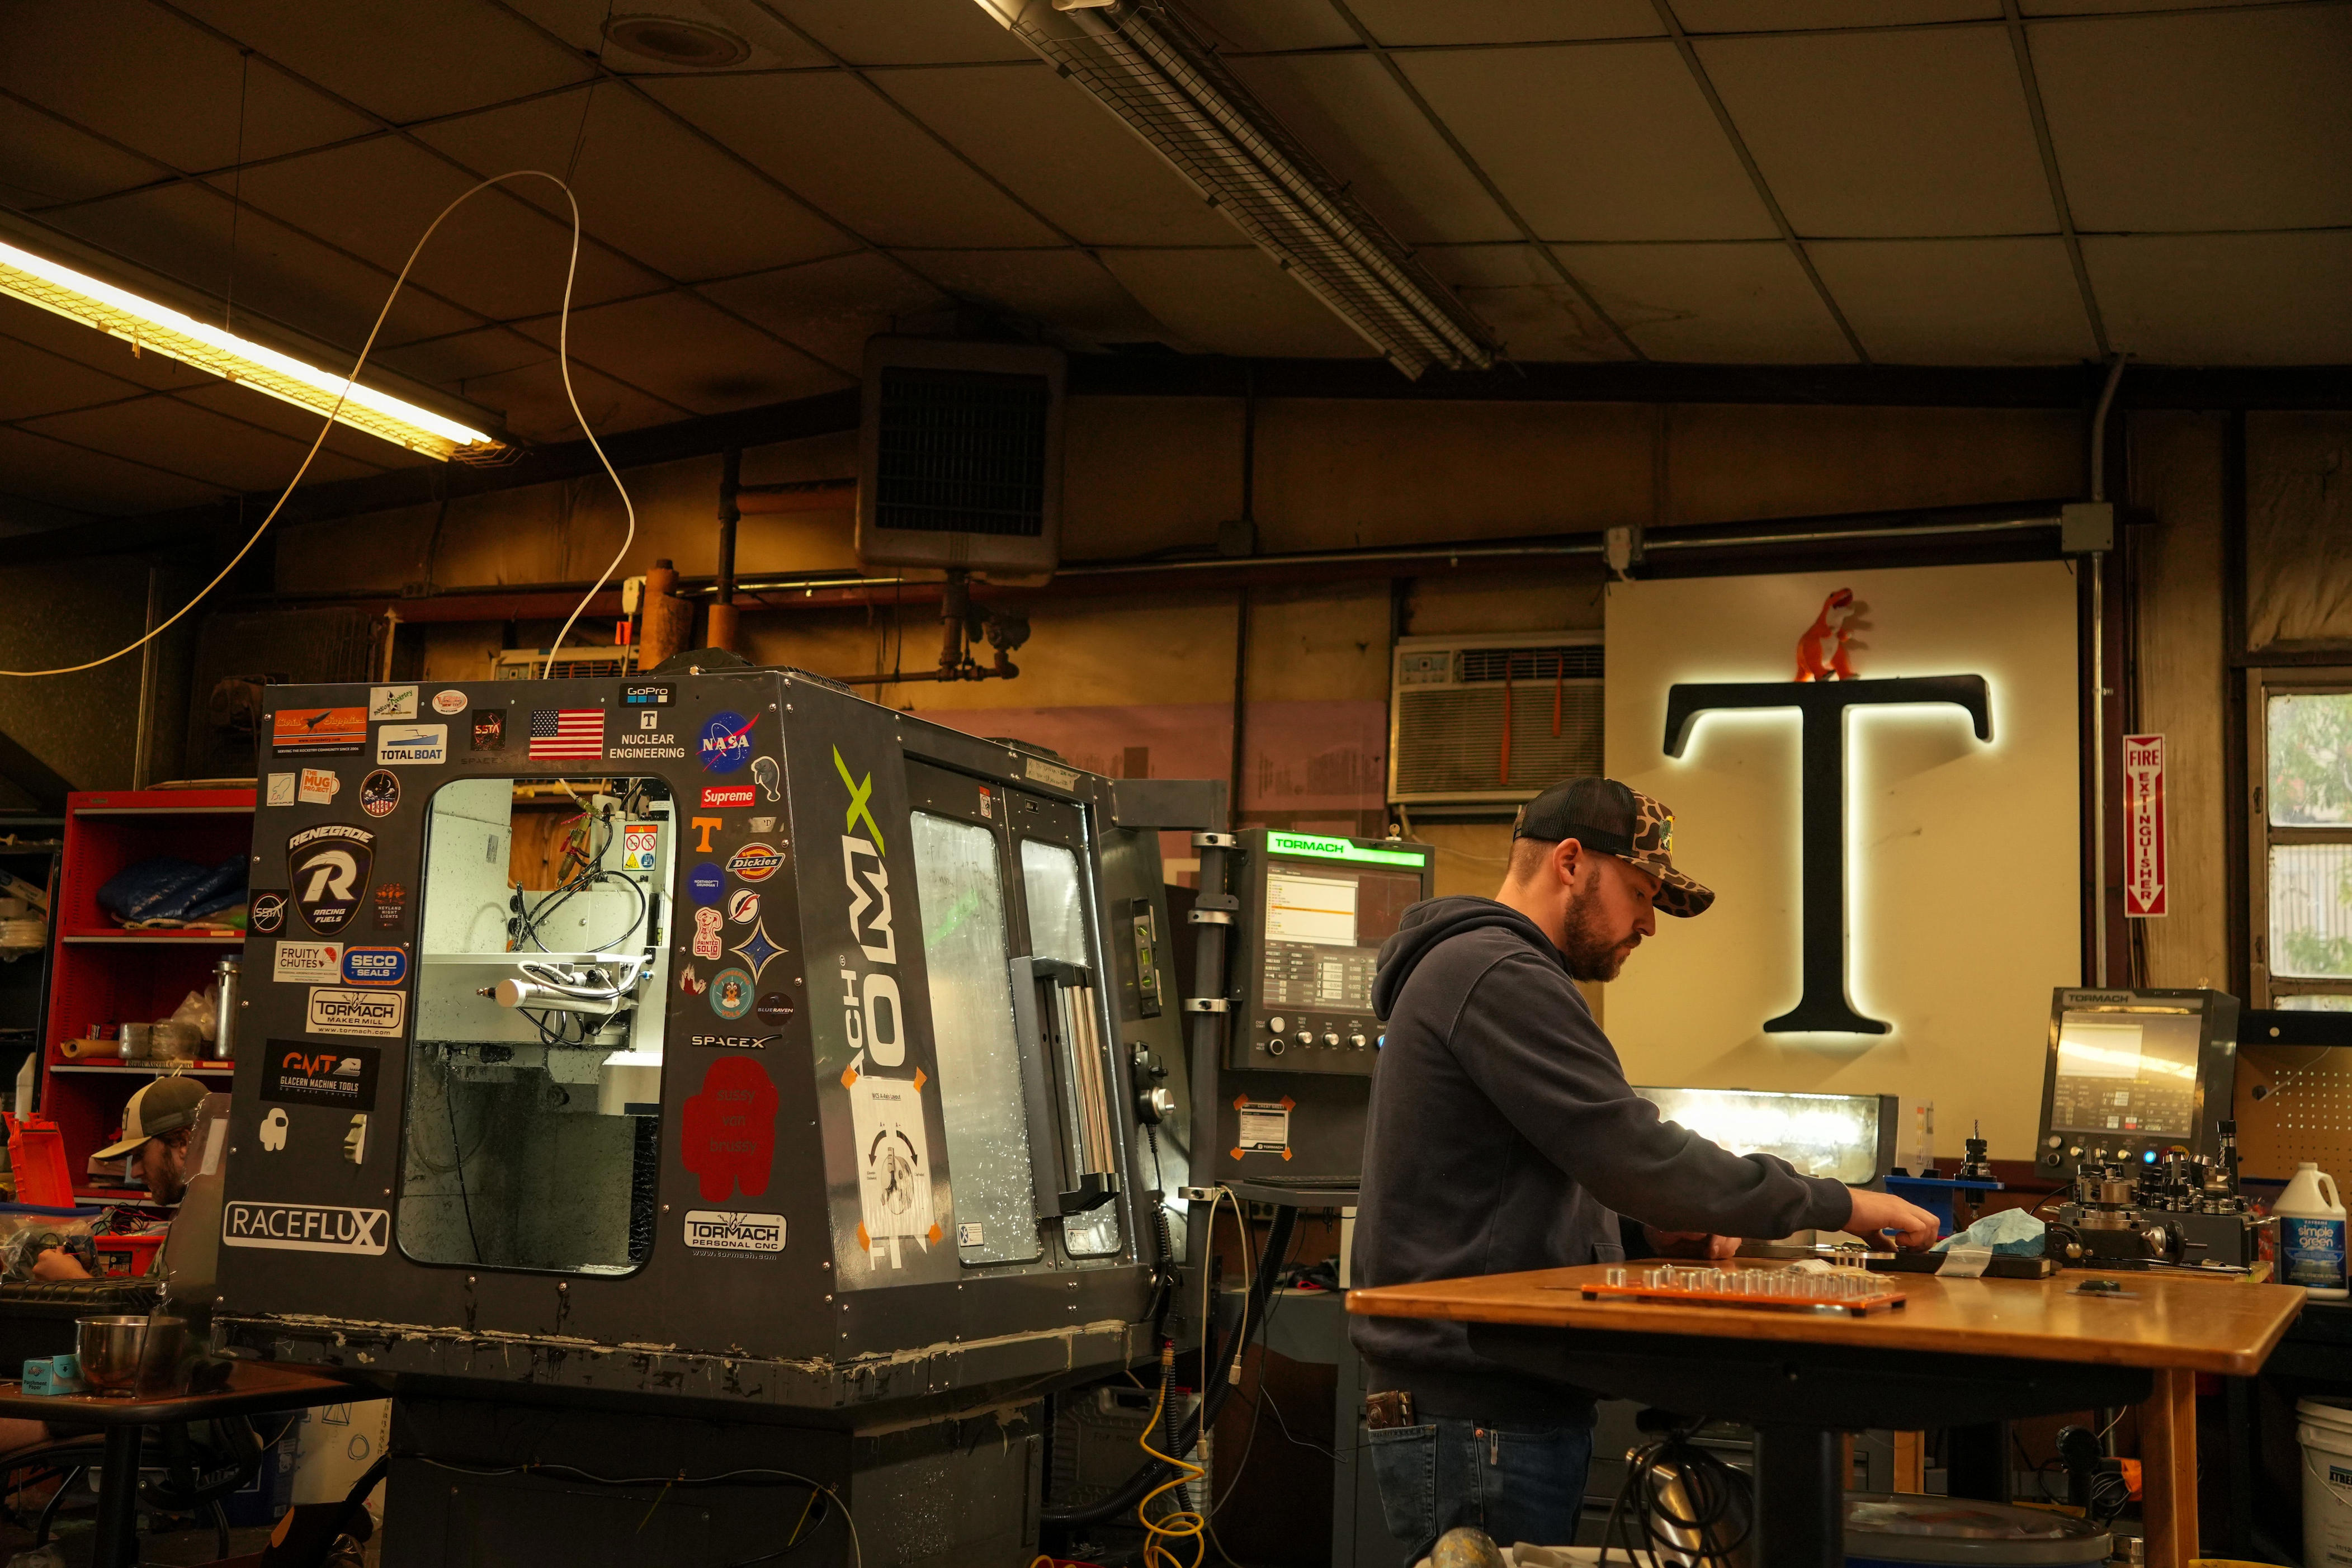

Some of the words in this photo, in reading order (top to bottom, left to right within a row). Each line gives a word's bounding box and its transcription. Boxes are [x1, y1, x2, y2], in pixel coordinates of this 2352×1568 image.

[627, 687, 668, 695] GoPro
[643, 713, 655, 727] T
[621, 734, 674, 745] NUCLEAR
[702, 734, 750, 752] NASA
[610, 747, 685, 758] ENGINEERING
[2129, 749, 2160, 767] FIRE
[304, 776, 330, 787] MUG
[704, 788, 753, 805] Supreme
[289, 825, 374, 849] RENEGADE
[691, 816, 722, 852] T
[2139, 771, 2152, 900] EXTINGUISHER
[1276, 838, 1344, 853] TORMACH
[1664, 674, 1992, 1034] T
[733, 857, 778, 867] Dickies
[281, 948, 319, 959] FRUITY
[351, 955, 398, 966] SECO
[281, 958, 317, 968] CHUTES
[714, 970, 750, 986] ENGINEERING
[2069, 994, 2128, 1003] TORMACH
[315, 1000, 395, 1018] TORMACH
[721, 1009, 741, 1017] VOLS
[691, 1035, 782, 1048] SPACEX
[282, 1052, 337, 1078] GMT
[280, 1075, 308, 1087] GLACERN
[309, 1079, 337, 1089] MACHINE
[339, 1081, 358, 1092] TOOLS
[717, 1089, 756, 1105] sussy
[722, 1114, 746, 1126] van
[710, 1136, 758, 1156] brussy
[233, 1208, 383, 1246] RACEFLUX
[687, 1221, 780, 1242] TORMACH
[2298, 1225, 2334, 1239] simple
[693, 1239, 750, 1248] PERSONAL
[2299, 1236, 2334, 1248] green
[692, 1250, 777, 1260] www.tormach.com
